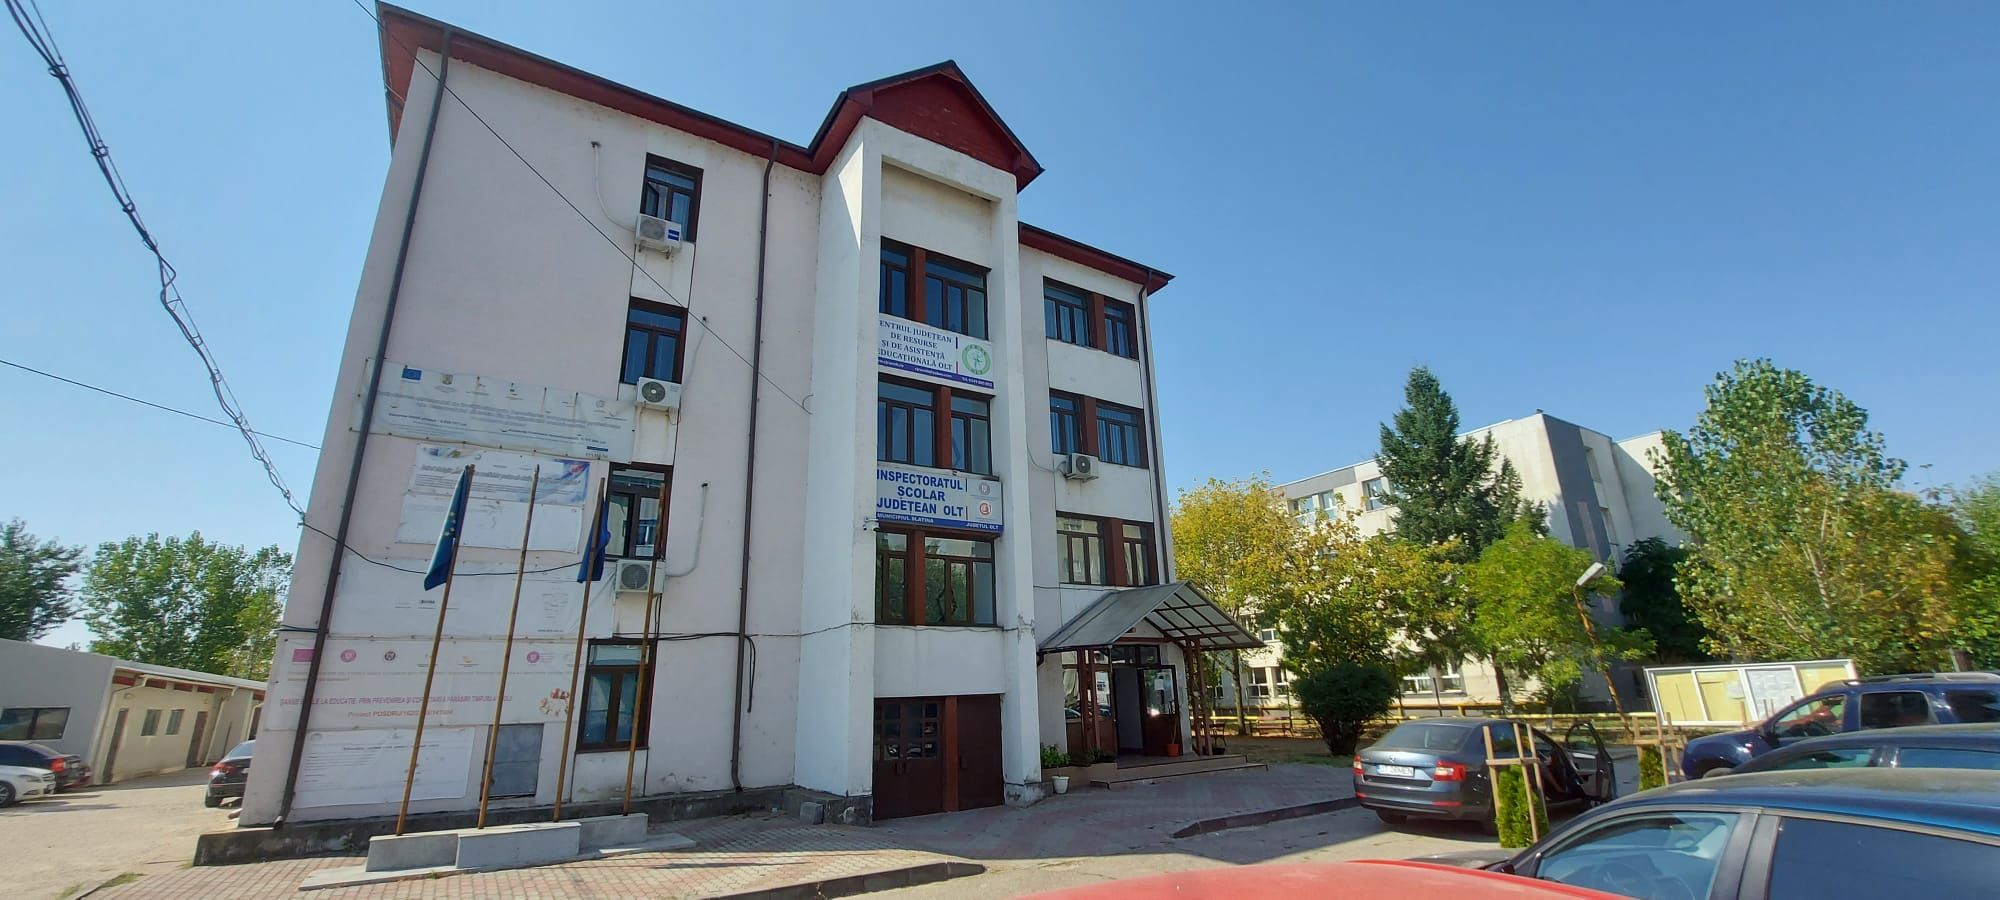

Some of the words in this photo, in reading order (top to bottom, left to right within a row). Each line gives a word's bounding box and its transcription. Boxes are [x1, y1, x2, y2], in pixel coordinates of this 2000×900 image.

[880, 320, 912, 333] ENTRUL
[890, 332, 902, 340] DE
[903, 335, 938, 349] RESURSE
[892, 342, 902, 351] DE
[879, 347, 937, 367] DUCAȚIONALĂ
[938, 362, 953, 371] OLT
[876, 469, 963, 490] INSPECTORATUL
[897, 485, 945, 501] ȘCOLAR
[876, 497, 937, 515] JUDEȚEAN
[943, 505, 964, 517] OLT
[877, 512, 911, 521] MUNICIPIUL
[911, 516, 934, 524] SLATINA
